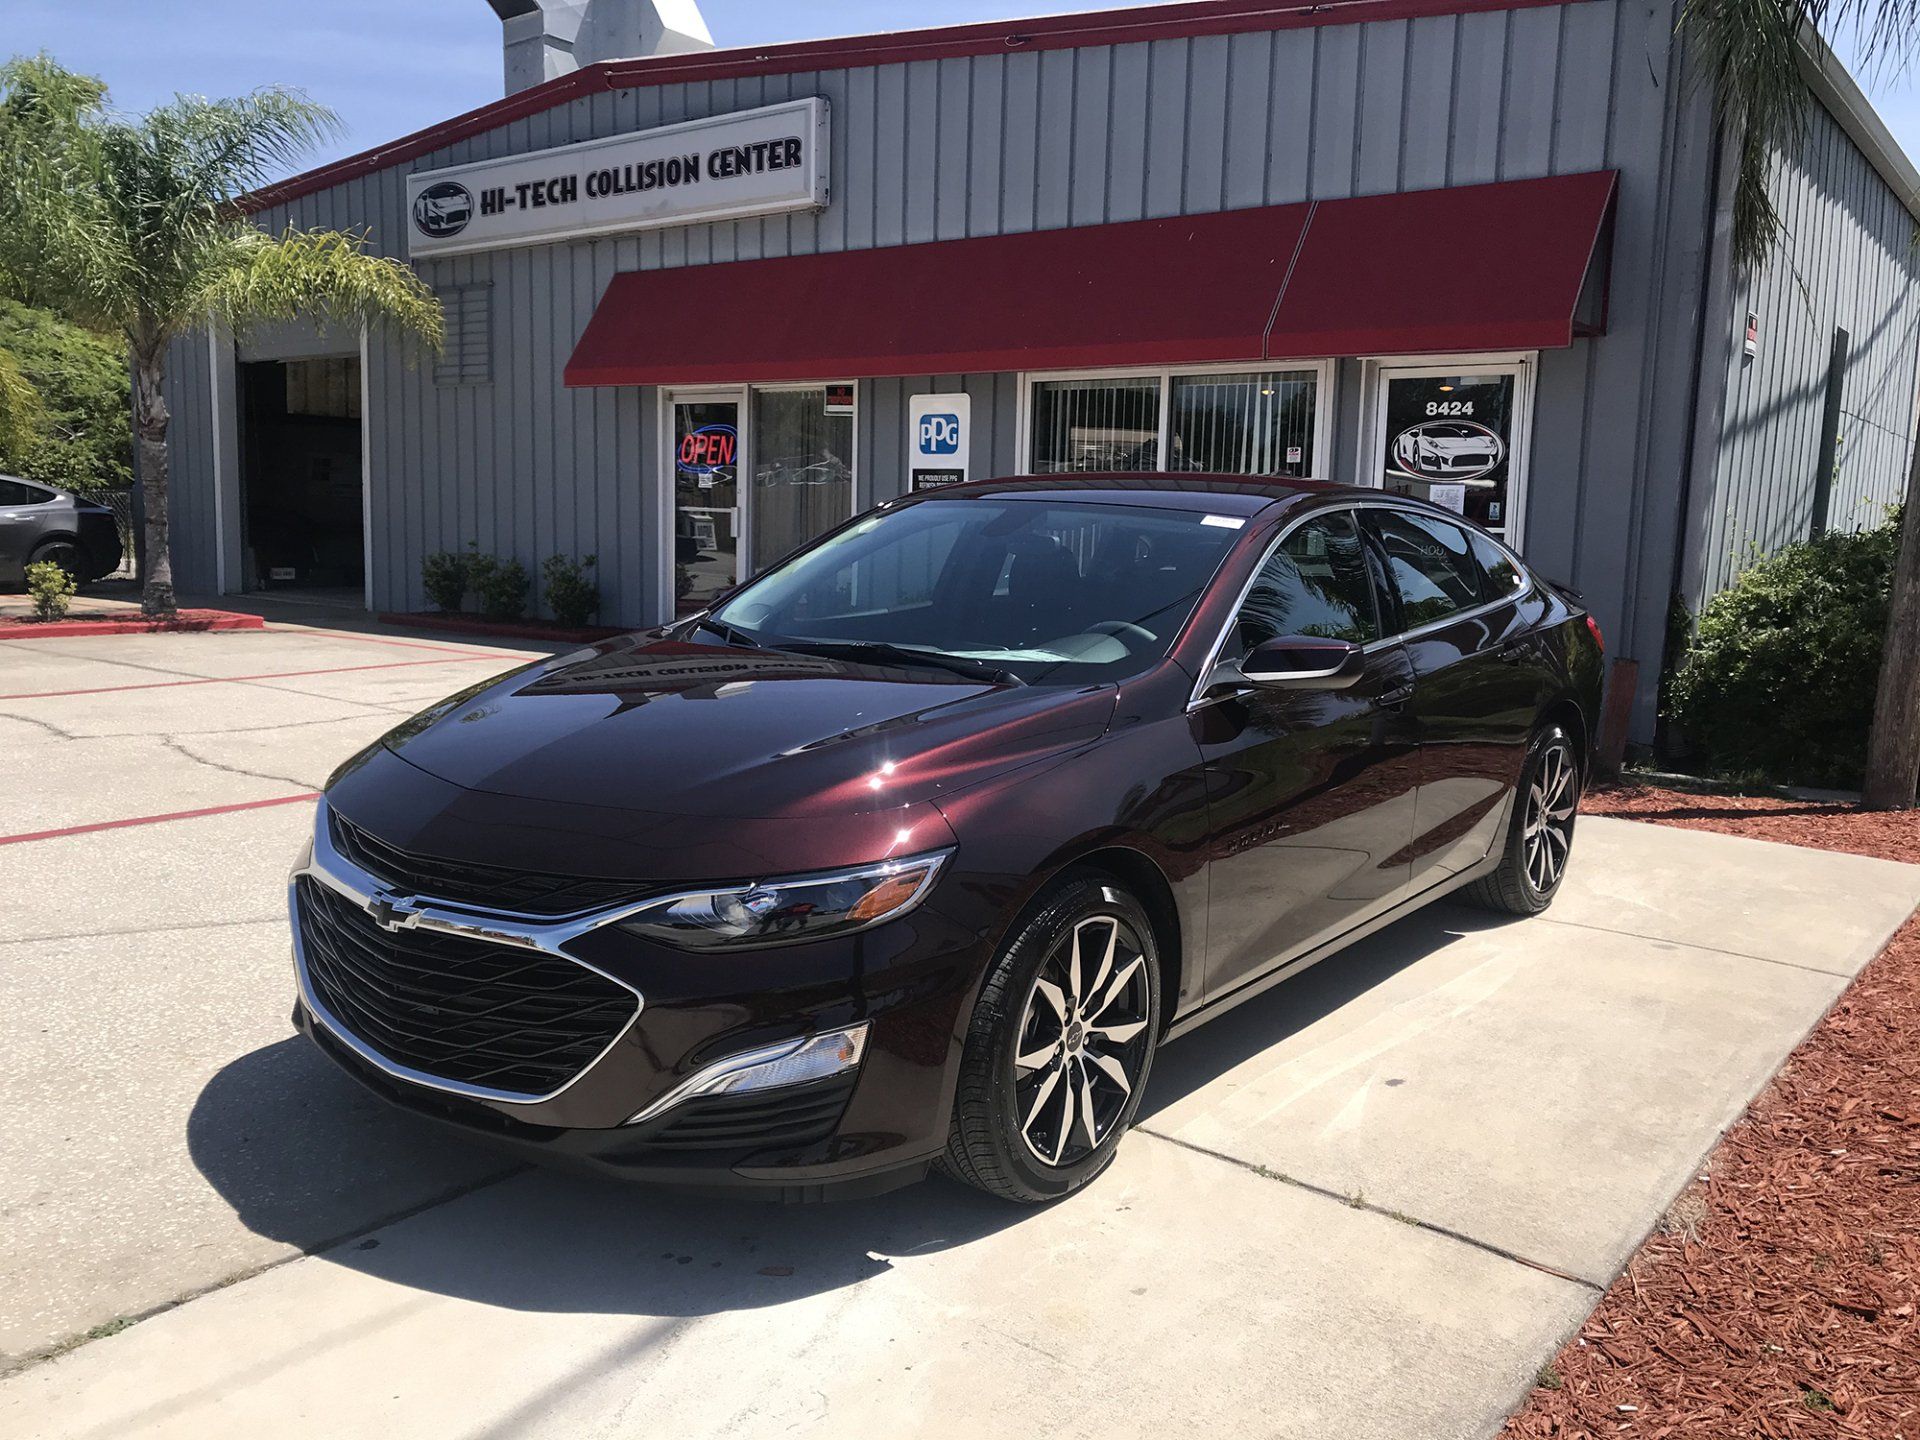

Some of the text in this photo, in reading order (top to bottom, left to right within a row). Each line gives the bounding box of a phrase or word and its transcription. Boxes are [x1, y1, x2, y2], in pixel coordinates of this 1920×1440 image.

[480, 136, 802, 217] HI-TECH COLLISION CENTER
[1425, 401, 1474, 416] 8424
[681, 434, 734, 465] OPEN
[920, 417, 958, 452] PPG
